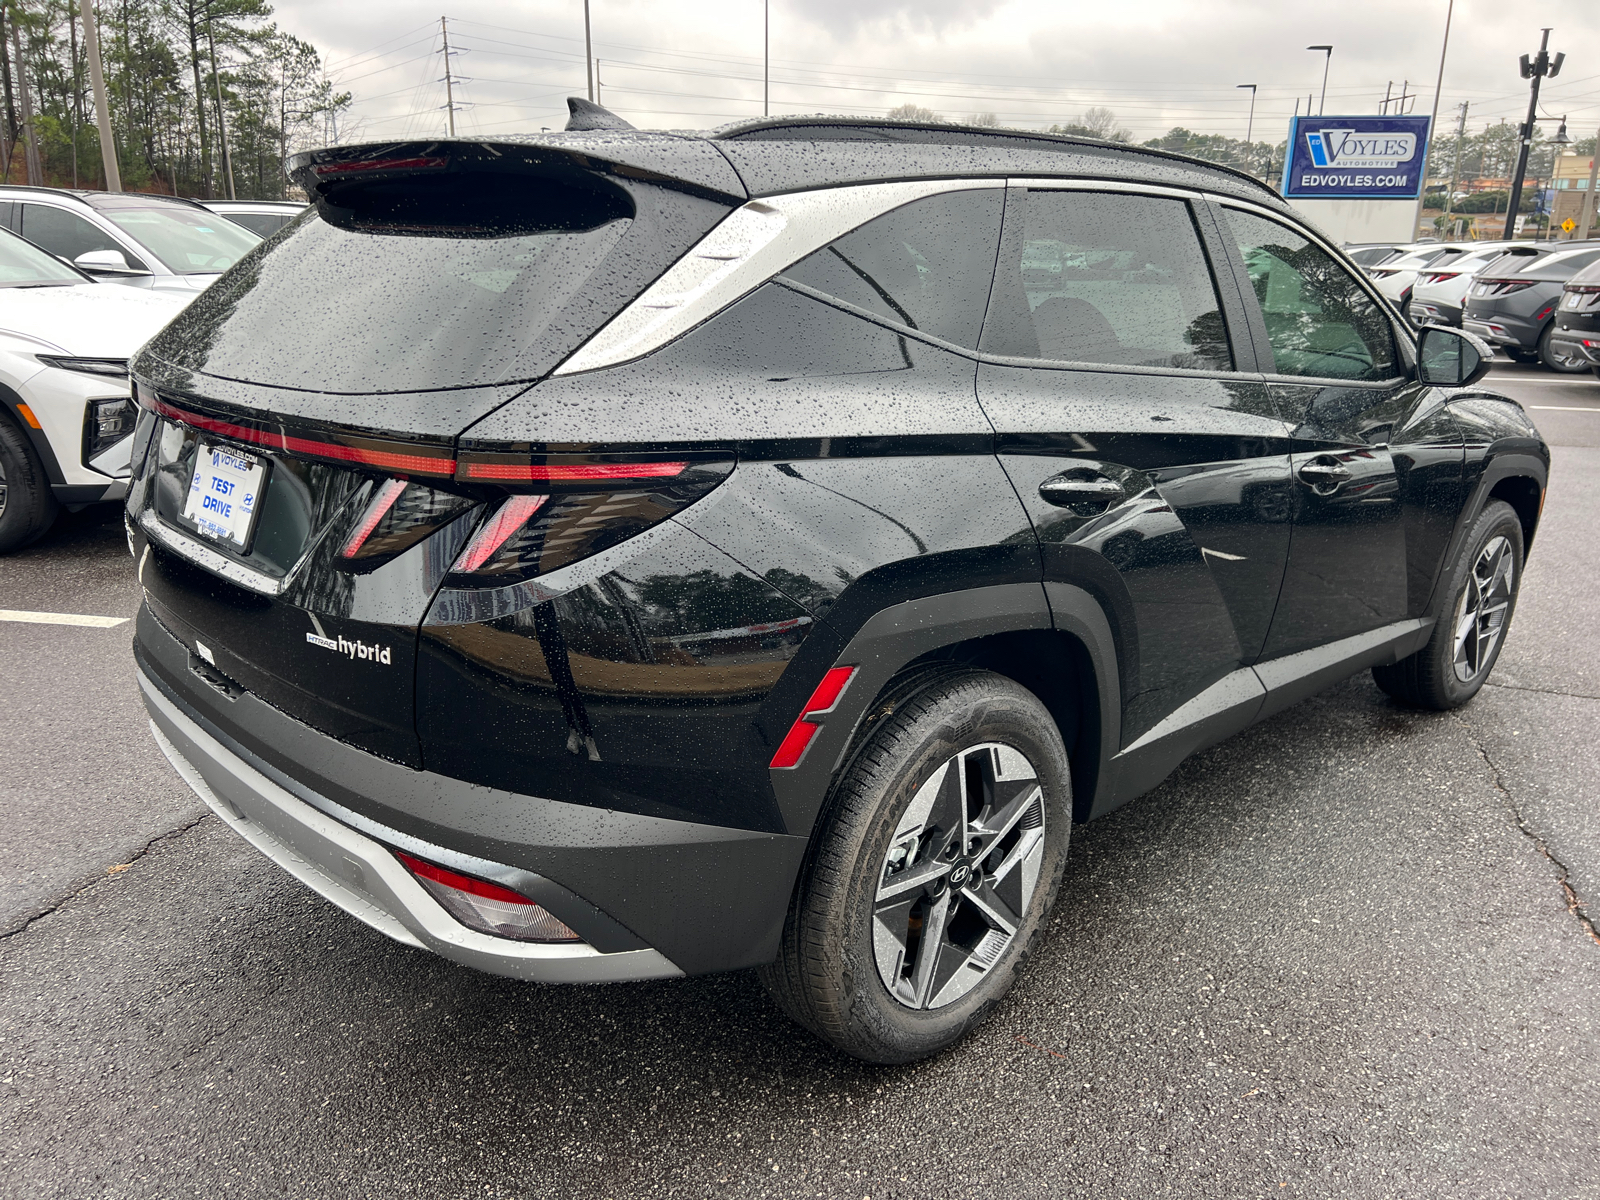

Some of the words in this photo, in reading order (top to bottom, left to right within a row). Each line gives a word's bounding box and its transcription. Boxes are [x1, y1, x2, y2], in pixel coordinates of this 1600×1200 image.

[1322, 132, 1408, 162] VOYLES
[1302, 176, 1408, 187] EDVOYLES.COM
[221, 454, 247, 472] VOYLES
[212, 476, 235, 496] TEST
[202, 495, 232, 518] DRIVE
[308, 636, 334, 648] HTRAC
[338, 635, 391, 665] hybrid
